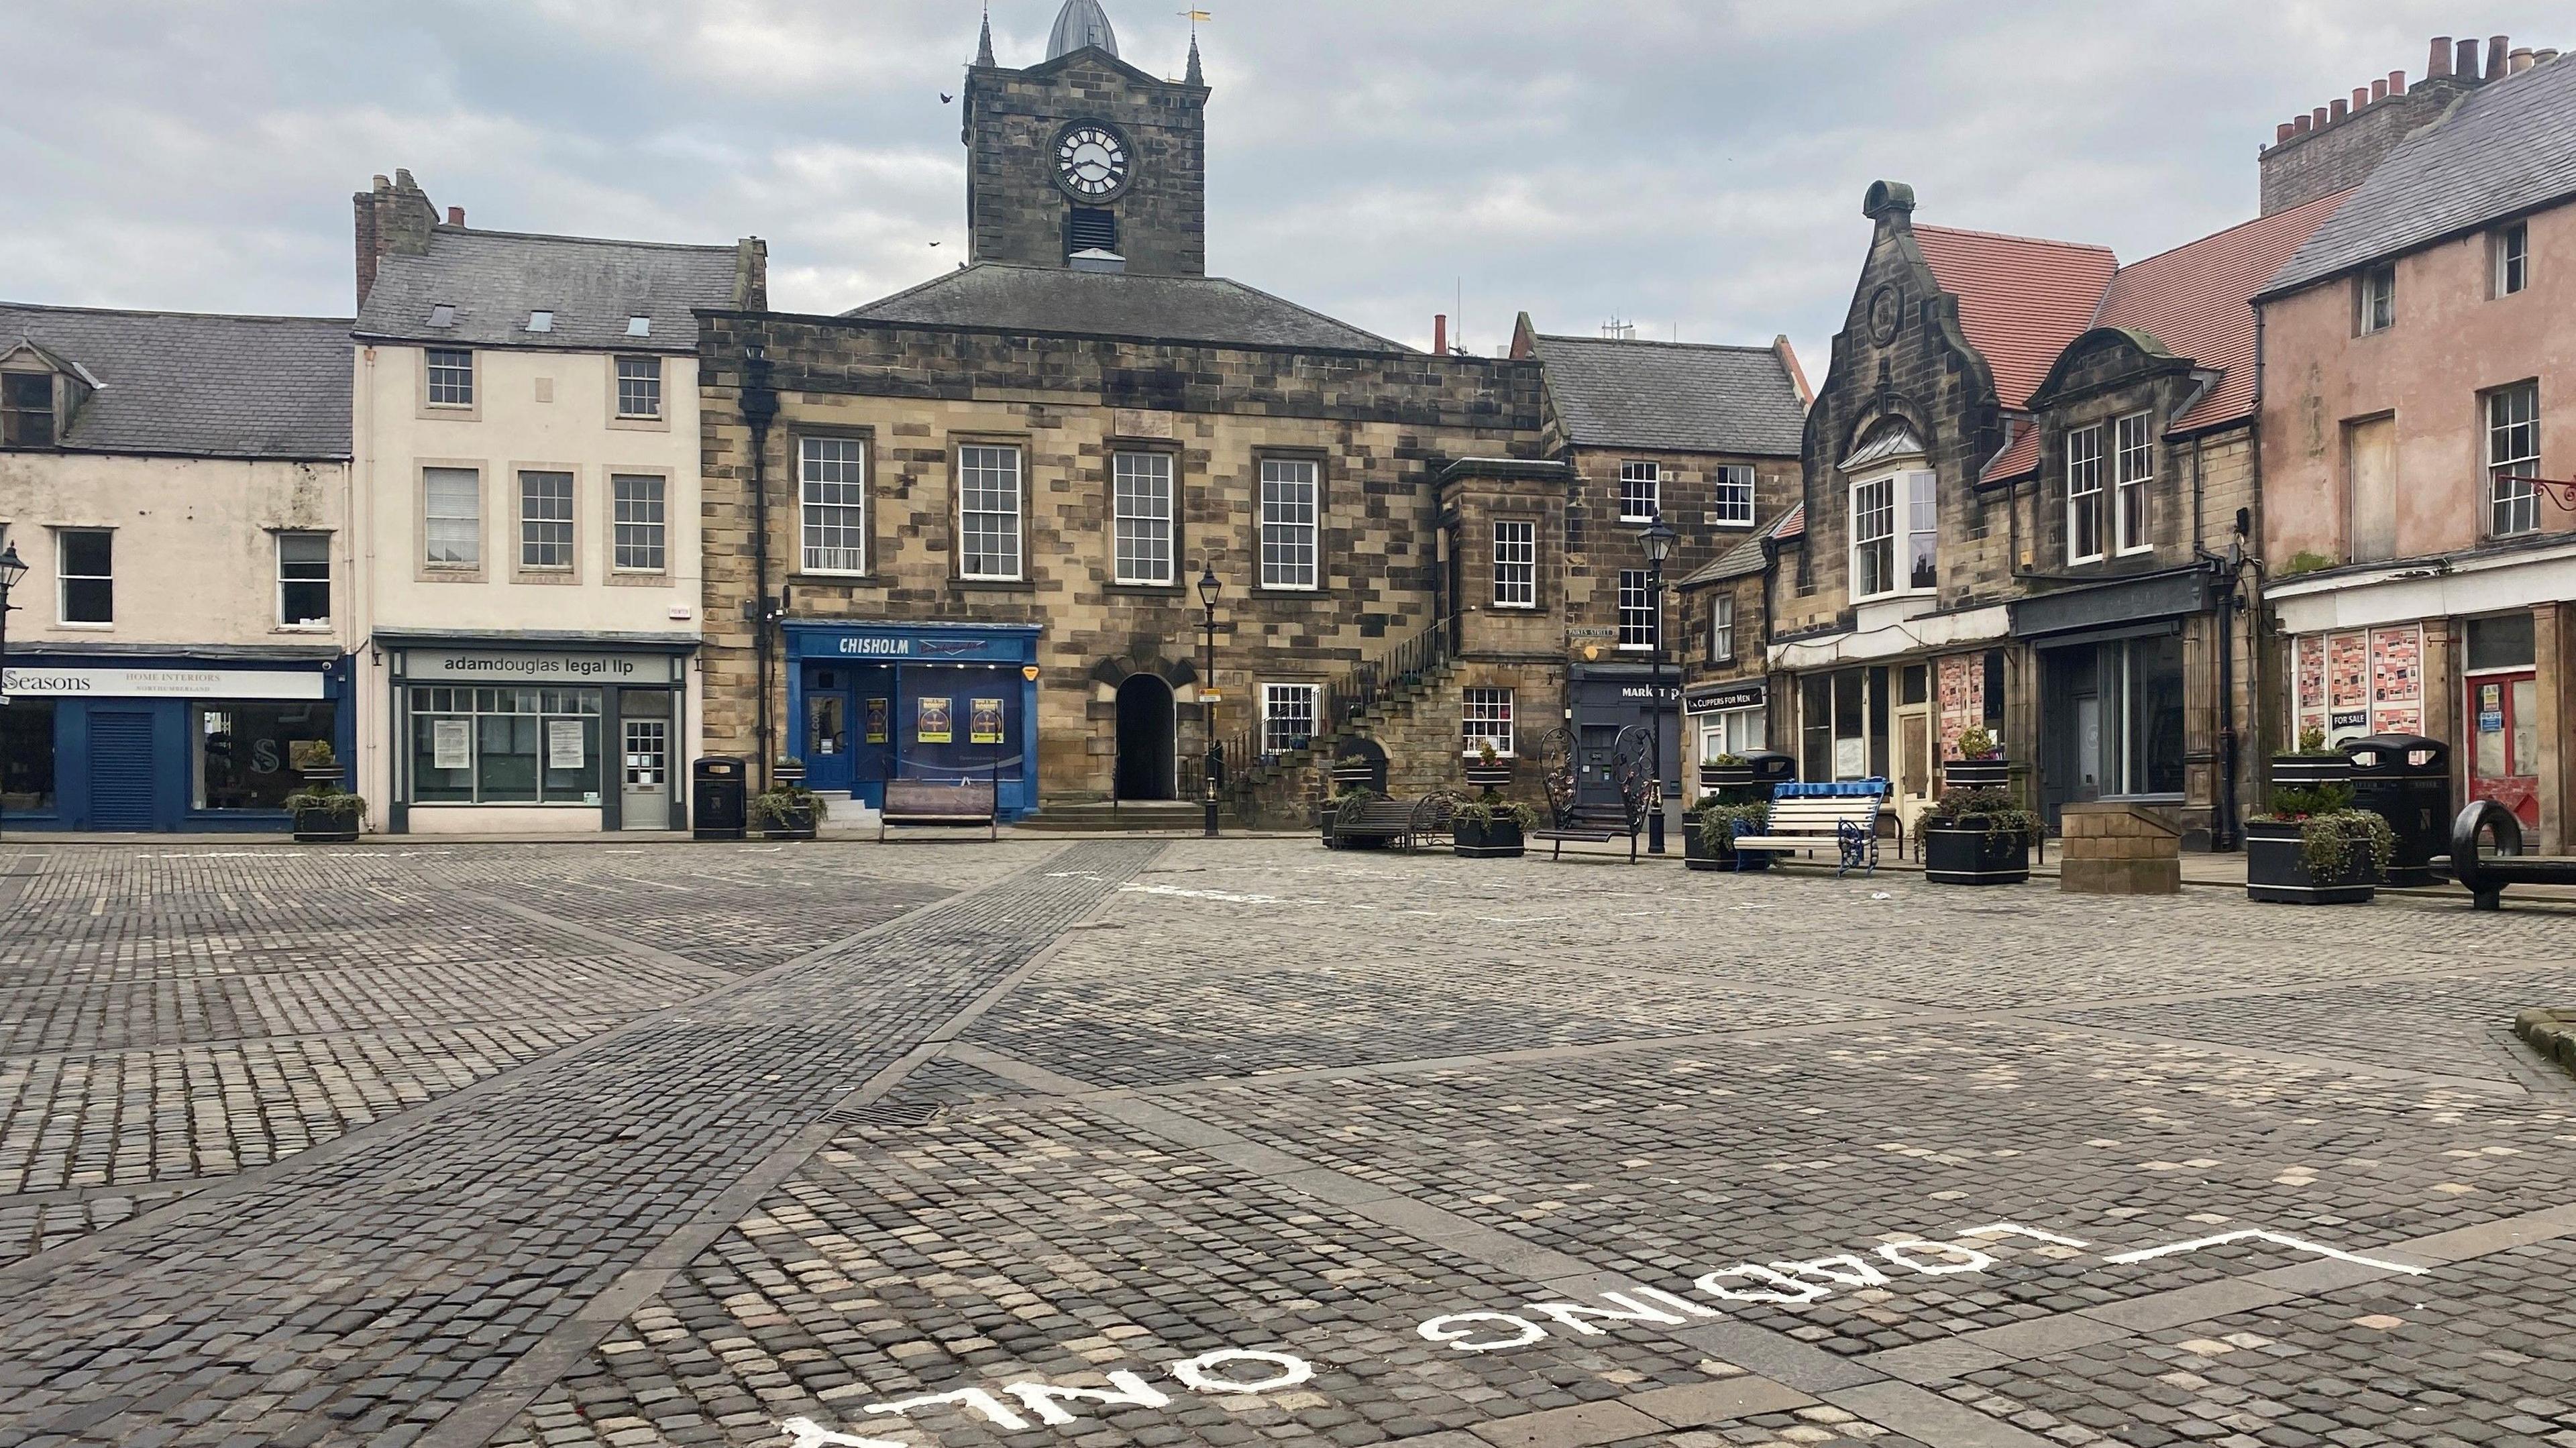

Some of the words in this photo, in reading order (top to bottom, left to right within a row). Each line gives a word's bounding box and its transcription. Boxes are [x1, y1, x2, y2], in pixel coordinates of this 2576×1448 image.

[839, 638, 908, 655] CHISHOLM
[444, 656, 559, 674] adamdouglas
[565, 658, 606, 675] legal
[612, 658, 633, 675] llp
[2, 669, 91, 691] Seasons
[162, 673, 220, 681] INTERIORS
[1697, 697, 1724, 708] CLIPPERS
[1725, 696, 1736, 704] FOR
[1736, 694, 1751, 703] MEN
[2334, 716, 2347, 725] FOR
[2348, 714, 2364, 724] SALE
[1417, 1223, 2091, 1353] LOADING
